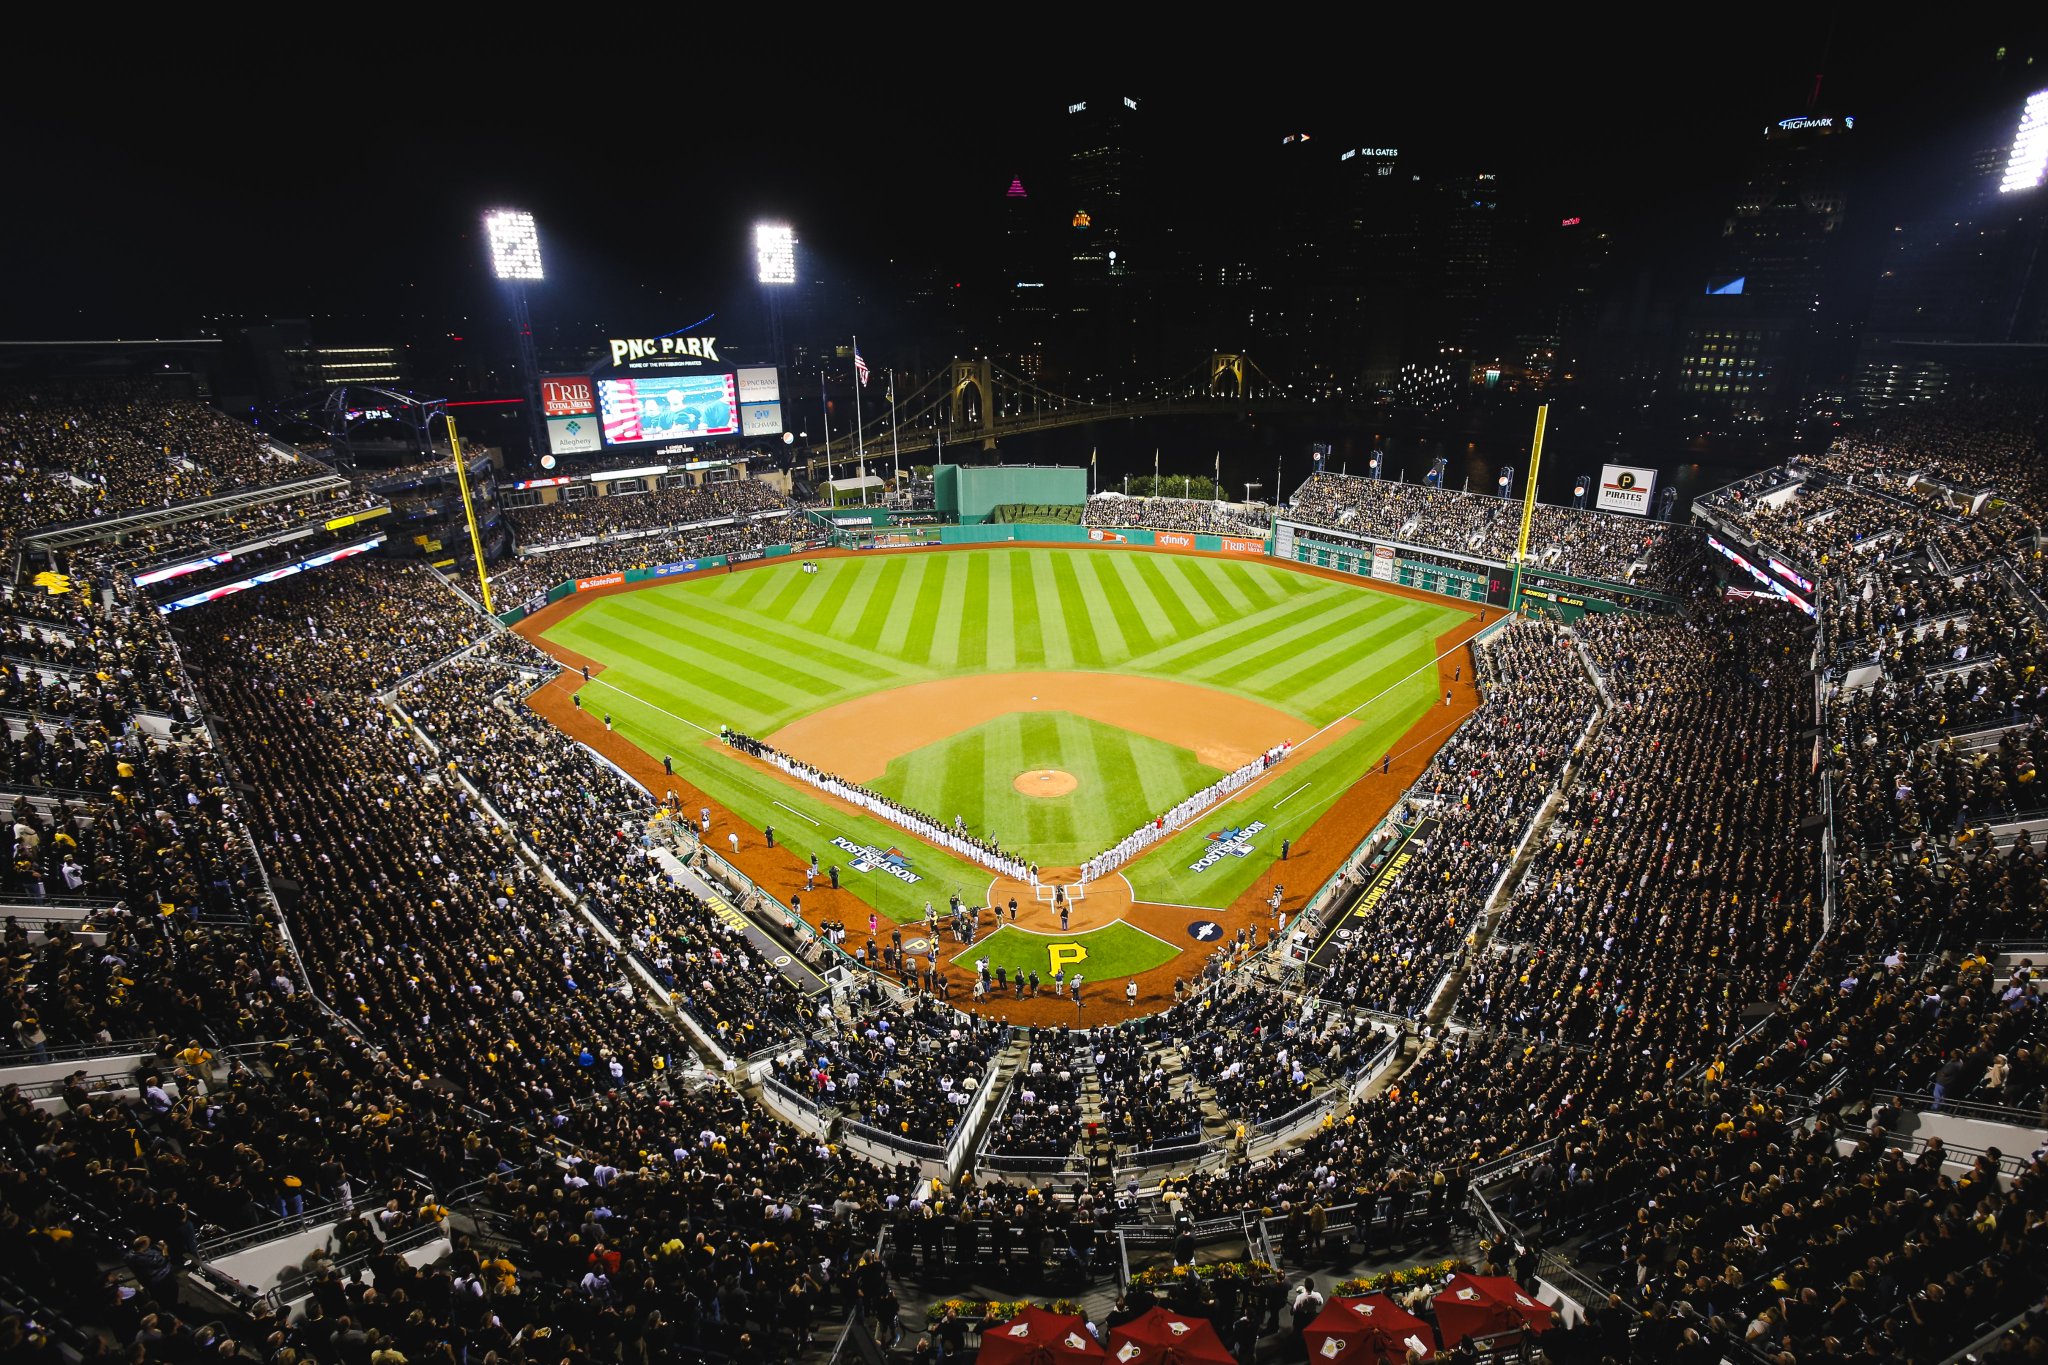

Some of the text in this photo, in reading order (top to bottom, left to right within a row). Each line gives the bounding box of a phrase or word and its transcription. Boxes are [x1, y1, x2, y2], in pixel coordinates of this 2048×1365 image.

[1068, 101, 1087, 114] UPMC
[1782, 118, 1832, 130] HIGHMARK
[1361, 148, 1375, 156] K&L
[1375, 148, 1398, 157] GATES
[609, 337, 720, 367] PNC PARK
[543, 382, 590, 401] TRIB
[546, 400, 592, 410] TOTAL MEDIA
[1622, 475, 1632, 487] P
[1605, 490, 1643, 502] PIRATES
[1604, 498, 1642, 508] CHARITIES
[1001, 504, 1084, 523] PIRATES
[1159, 535, 1190, 547] xfinity
[1222, 539, 1246, 551] TRIB
[1300, 543, 1363, 559] NATIONAL LEAGUE
[1402, 563, 1443, 576] AMERICAN
[1445, 572, 1477, 583] LEAGUE
[1561, 597, 1584, 606] BLASTS
[1188, 820, 1268, 873] POSTSEASON
[829, 836, 923, 884] POSTSEASON
[1353, 886, 1386, 917] WELCOME
[1382, 867, 1401, 881] PNC
[1392, 853, 1413, 869] PARK
[1047, 941, 1088, 978] P
